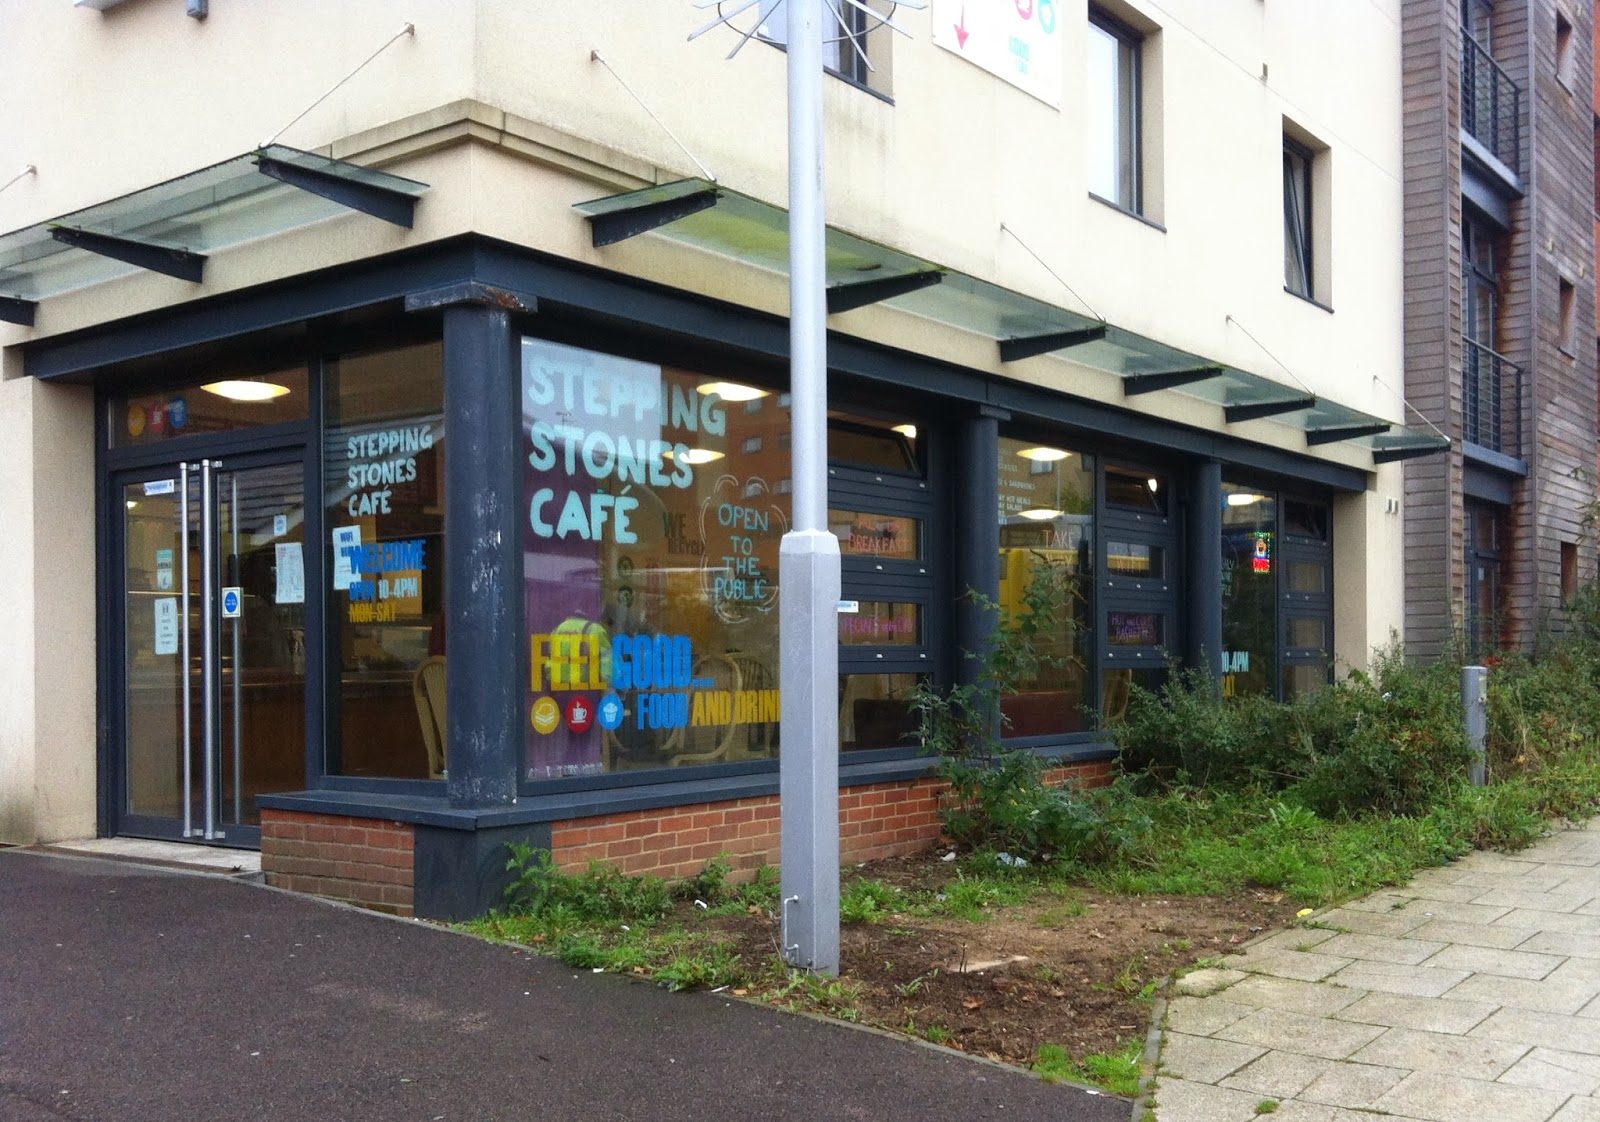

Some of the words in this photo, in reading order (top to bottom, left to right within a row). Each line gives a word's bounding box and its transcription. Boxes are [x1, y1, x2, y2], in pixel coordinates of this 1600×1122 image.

[528, 356, 727, 438] STEPPING
[347, 425, 432, 458] STEPPING
[528, 421, 695, 489] STONES
[347, 458, 417, 489] STONES
[348, 486, 392, 516] CAFÉ
[529, 484, 640, 545] CAFÉ
[717, 503, 769, 531] OPEN
[730, 535, 753, 556] TO
[1041, 530, 1076, 549] TAKE
[350, 540, 426, 574] WELCOME
[721, 556, 761, 576] THE
[378, 577, 418, 599] 10-4PM
[714, 577, 768, 601] PUBLIC
[531, 633, 607, 692] FEEL
[637, 692, 689, 730] FOOD
[692, 690, 731, 727] AND
